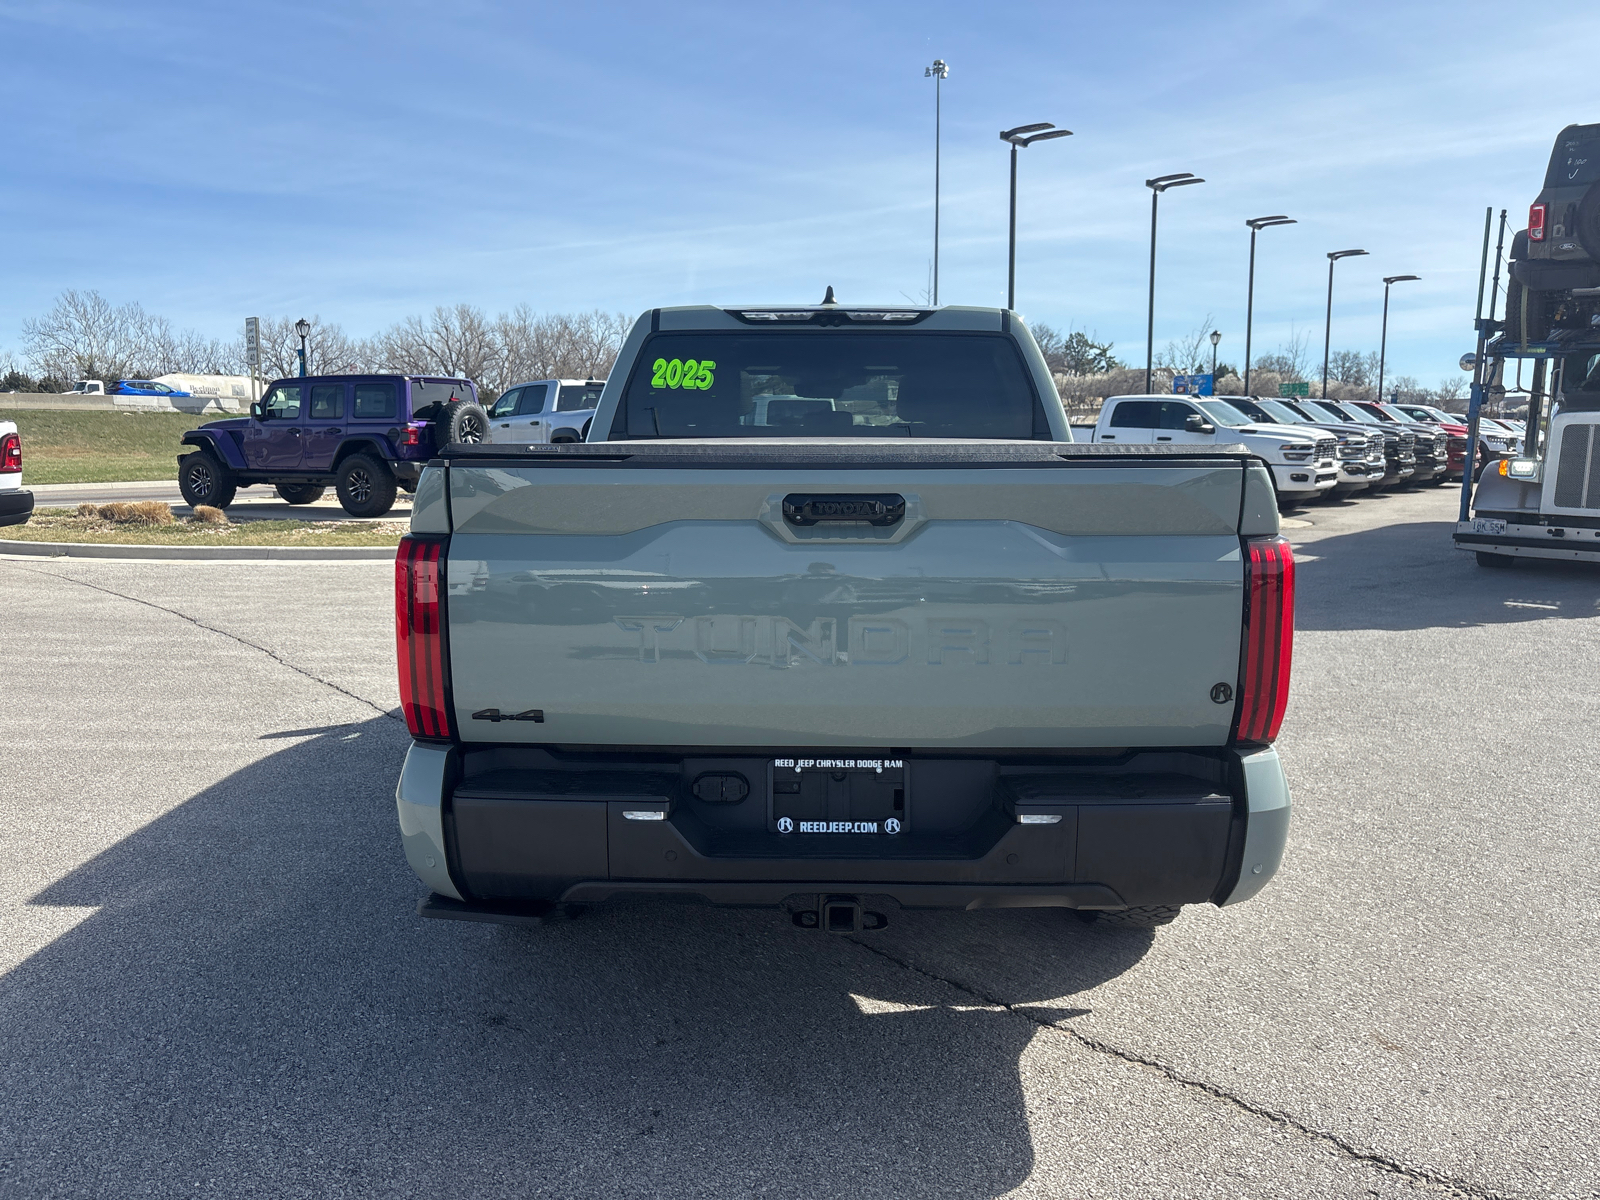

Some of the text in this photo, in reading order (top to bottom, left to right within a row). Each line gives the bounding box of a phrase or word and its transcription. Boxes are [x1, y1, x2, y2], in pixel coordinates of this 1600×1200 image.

[651, 358, 716, 391] 2025
[815, 502, 873, 515] TOYOTA
[613, 615, 1069, 665] TUNDRA
[774, 759, 903, 768] REED JEEP CHRYSLER DODGE RAM
[800, 821, 878, 833] REEDJEEP.COM
